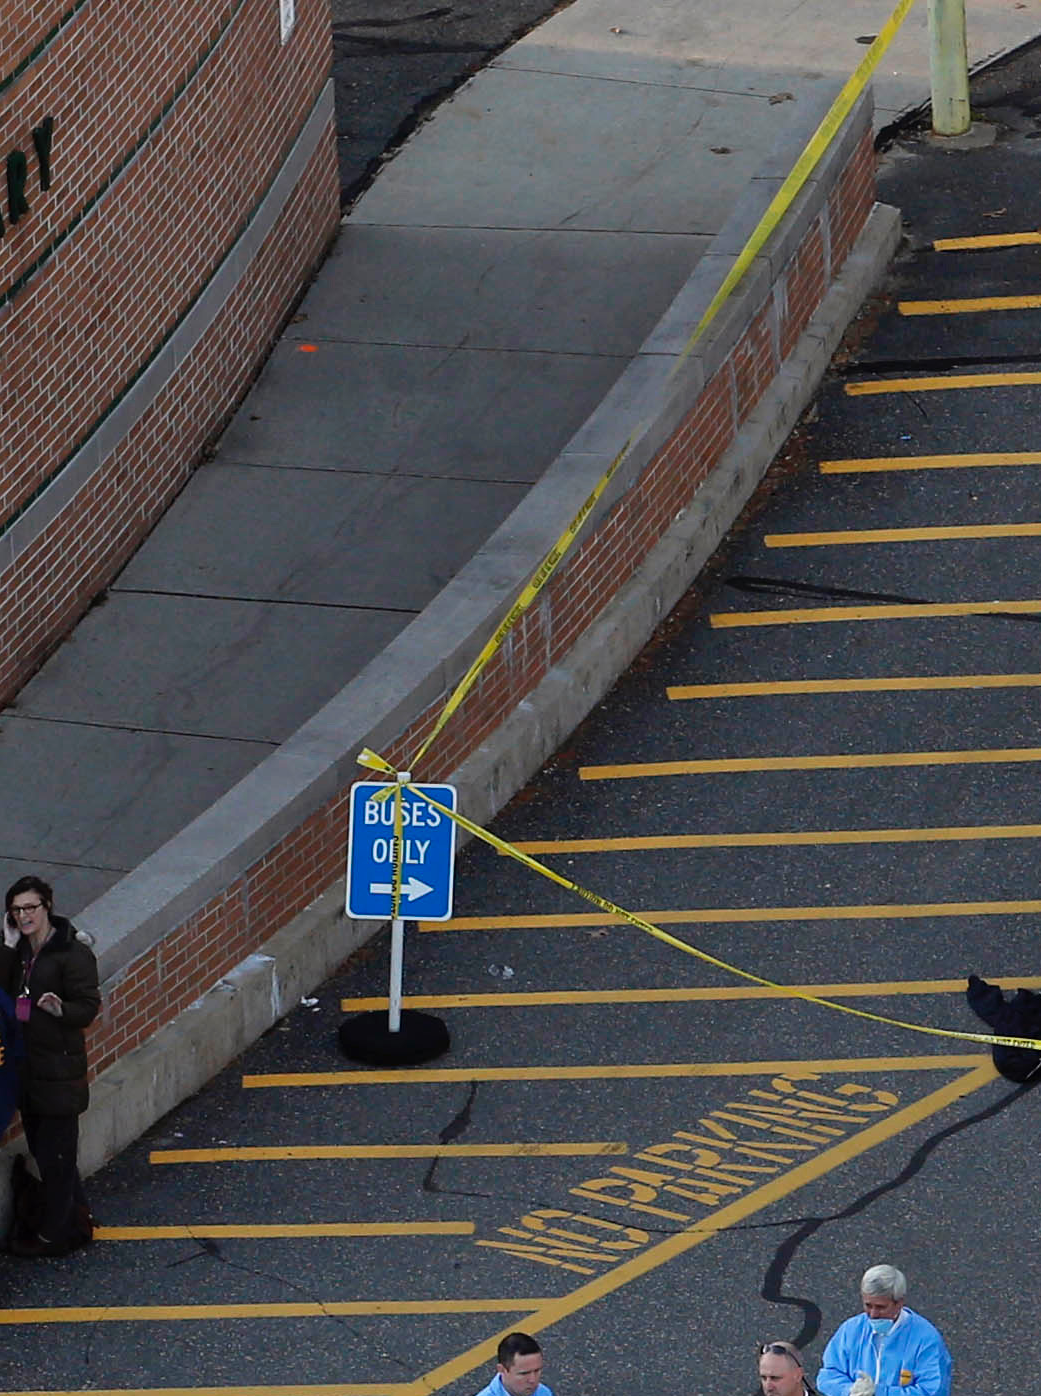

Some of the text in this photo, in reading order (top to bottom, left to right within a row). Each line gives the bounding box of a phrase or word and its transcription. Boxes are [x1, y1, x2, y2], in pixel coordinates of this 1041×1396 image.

[364, 801, 441, 827] BUSES
[474, 1072, 899, 1275] NO PARKING
